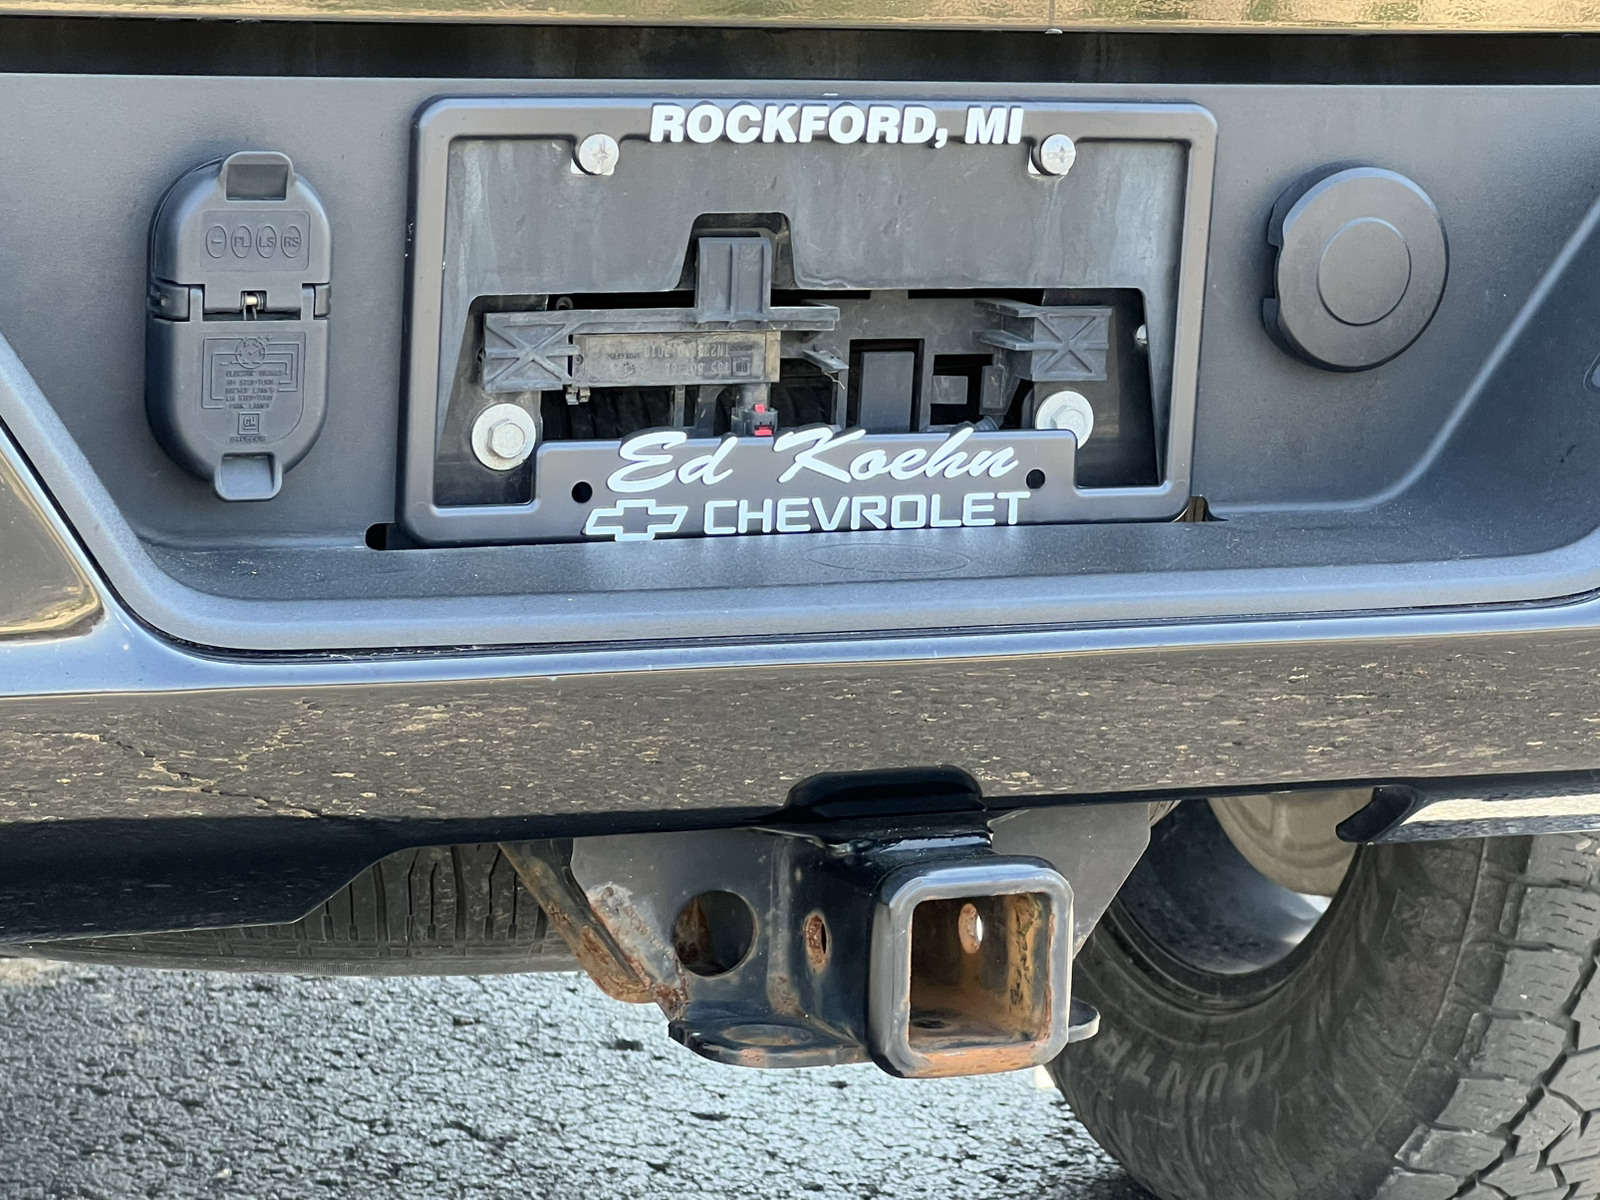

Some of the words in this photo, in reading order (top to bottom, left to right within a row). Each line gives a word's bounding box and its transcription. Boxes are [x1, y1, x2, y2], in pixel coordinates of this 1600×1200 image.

[650, 104, 948, 148] ROCKFORD,
[964, 105, 1024, 145] MI
[234, 236, 250, 248] PL
[259, 236, 274, 248] LS
[284, 236, 299, 248] RS
[606, 430, 738, 492] Ed
[773, 426, 1019, 484] Koehn
[703, 491, 1031, 534] CHEVROLET
[1093, 1022, 1292, 1106] COUNTR
